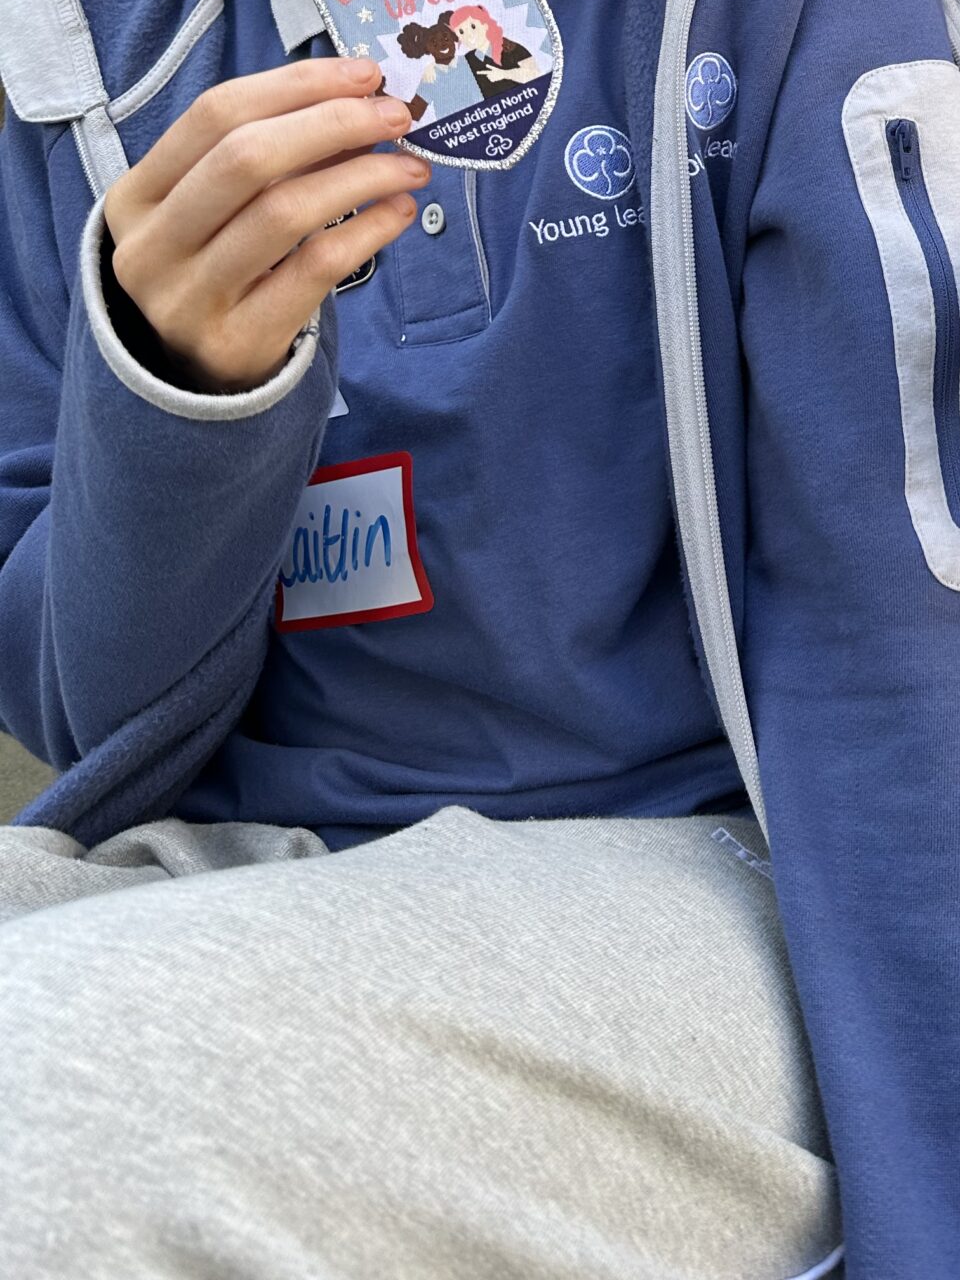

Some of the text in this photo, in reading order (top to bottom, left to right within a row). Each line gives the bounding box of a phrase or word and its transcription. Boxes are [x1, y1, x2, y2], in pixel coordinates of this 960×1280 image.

[429, 86, 539, 140] Girlguiding North
[445, 103, 533, 149] West England
[529, 211, 610, 245] Young
[279, 504, 392, 588] aitlin
